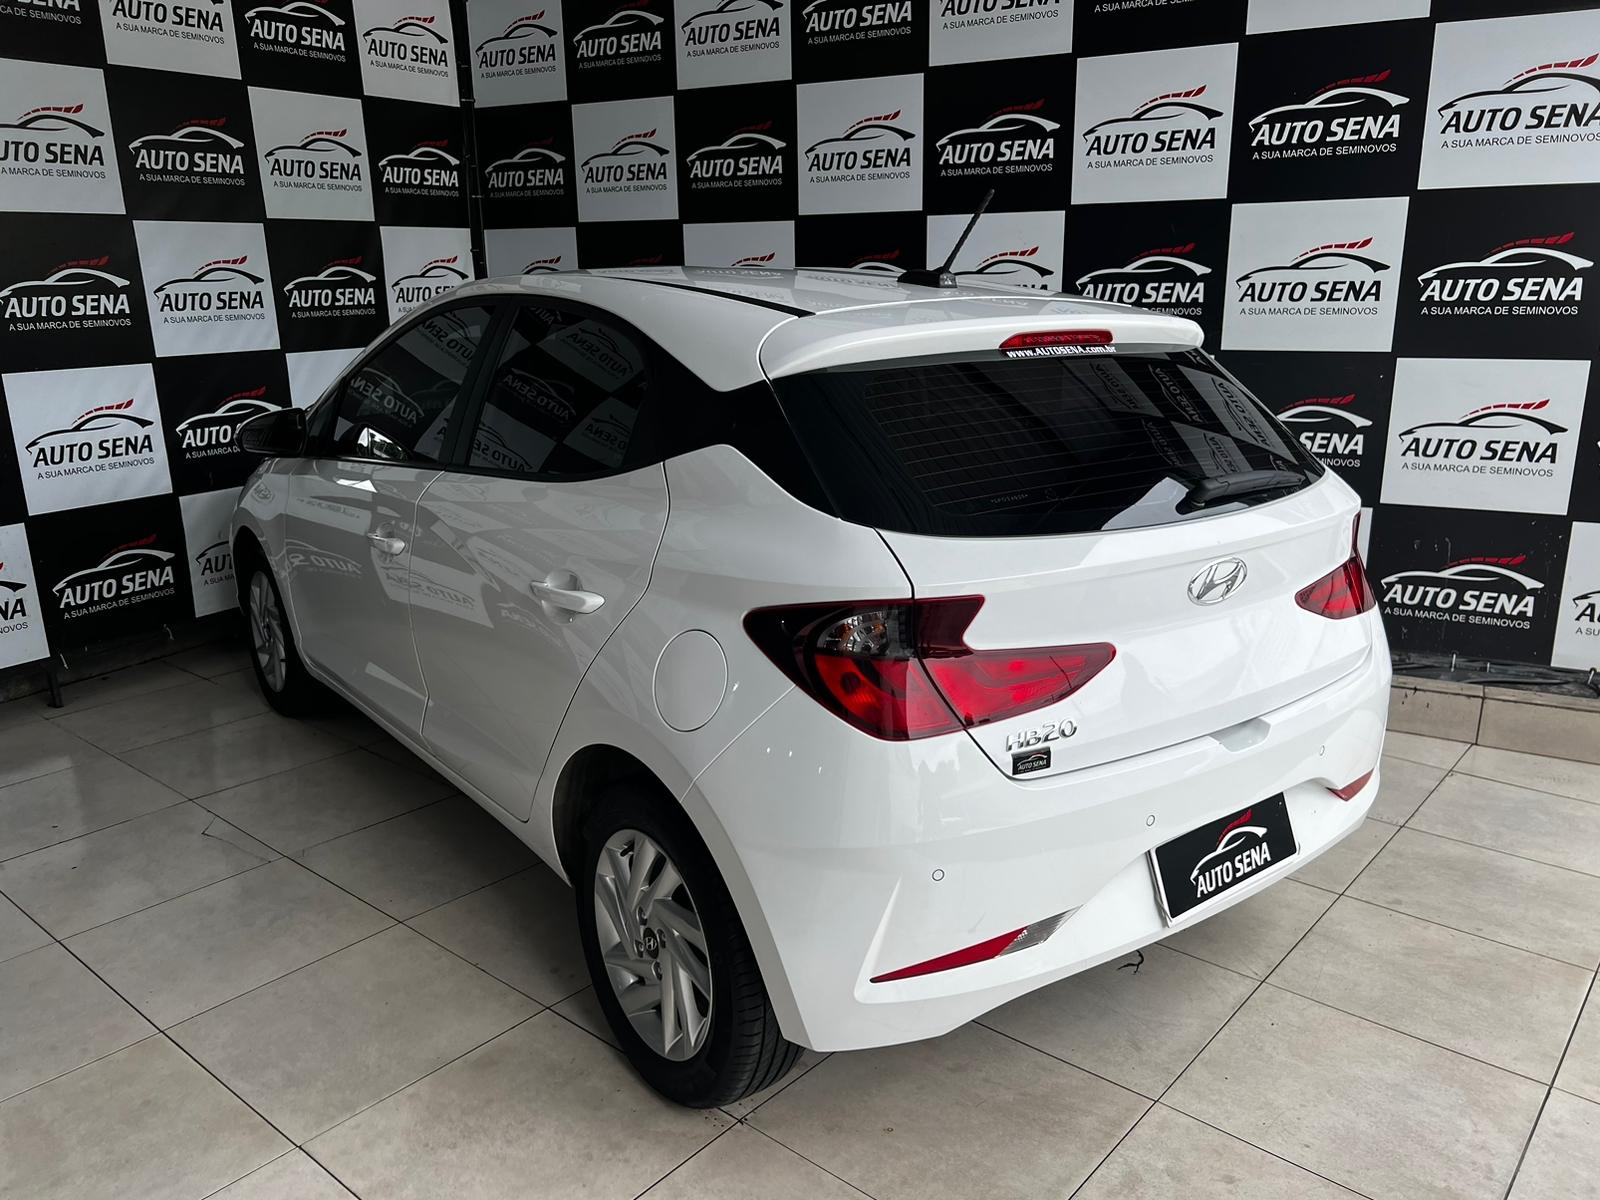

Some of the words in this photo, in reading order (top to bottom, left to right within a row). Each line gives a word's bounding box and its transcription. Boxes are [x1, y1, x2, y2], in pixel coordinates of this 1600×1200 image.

[14, 7, 27, 16] DE
[28, 9, 82, 24] SEMINOVOS
[112, 0, 167, 23] AUTO
[171, 5, 224, 32] SENA
[806, 8, 857, 33] AUTO
[859, 0, 912, 27] SENA
[1094, 4, 1101, 13] A
[1102, 2, 1120, 12] SUA
[1121, 0, 1154, 10] MARCA
[685, 23, 730, 46] AUTO
[733, 17, 780, 41] SENA
[942, 22, 949, 30] A
[949, 18, 966, 30] SUA
[966, 16, 996, 28] MARCA
[996, 14, 1008, 24] DE
[1009, 10, 1059, 22] SEMINOVOS
[116, 22, 122, 30] A
[123, 23, 140, 32] SUA
[140, 25, 168, 36] MARCA
[169, 29, 180, 38] DE
[181, 31, 224, 44] SEMINOVOS
[250, 19, 297, 43] AUTO
[301, 26, 345, 51] SENA
[576, 36, 617, 58] AUTO
[619, 31, 661, 54] SENA
[367, 38, 407, 60] AUTO
[410, 45, 448, 68] SENA
[479, 48, 516, 69] AUTO
[518, 43, 556, 65] SENA
[1440, 107, 1522, 134] AUTO
[1524, 101, 1600, 130] SENA
[1086, 132, 1149, 156] AUTO
[1151, 127, 1215, 152] SENA
[1251, 120, 1324, 146] AUTO
[1326, 114, 1400, 142] SENA
[0, 140, 40, 163] UTO
[44, 142, 104, 166] SENA
[939, 142, 995, 165] AUTO
[997, 138, 1054, 161] SENA
[1261, 150, 1280, 159] SUA
[1282, 148, 1317, 158] MARCA
[1319, 147, 1333, 156] DE
[1336, 143, 1396, 155] SEMINOVOS
[1441, 140, 1449, 148] A
[1451, 139, 1473, 148] SUA
[1475, 137, 1514, 146] MARCA
[1517, 136, 1532, 145] DE
[135, 149, 189, 171] AUTO
[193, 152, 244, 174] SENA
[270, 158, 316, 178] AUTO
[319, 161, 362, 181] SENA
[690, 158, 734, 178] AUTO
[737, 155, 782, 176] SENA
[808, 151, 858, 172] AUTO
[860, 147, 911, 169] SENA
[1095, 160, 1112, 168] SUA
[1113, 159, 1144, 167] MARCA
[1146, 158, 1158, 166] DE
[1160, 154, 1213, 165] SEMINOVOS
[8, 166, 40, 176] MARCA
[42, 168, 54, 177] DE
[56, 168, 106, 180] SEMINOVOS
[163, 174, 190, 183] MARCA
[191, 176, 202, 184] DE
[203, 177, 245, 186] SEMINOVOS
[382, 166, 421, 185] AUTO
[423, 169, 459, 187] SENA
[488, 170, 524, 188] AUTO
[526, 168, 564, 186] SENA
[584, 165, 624, 184] AUTO
[626, 162, 667, 181] SENA
[831, 174, 855, 182] MARCA
[868, 171, 910, 180] SEMINOVOS
[289, 289, 332, 308] AUTO
[335, 288, 375, 306] SENA
[396, 286, 432, 304] AUTO
[1081, 282, 1140, 304] AUTO
[1141, 282, 1204, 304] SENA
[1238, 281, 1308, 302] AUTO
[1310, 280, 1381, 302] SENA
[1420, 279, 1500, 301] AUTO
[1502, 277, 1583, 301] SENA
[4, 296, 66, 318] AUTO
[71, 294, 130, 316] SENA
[160, 292, 212, 312] AUTO
[216, 291, 264, 310] SENA
[1268, 307, 1302, 315] MARCA
[1304, 307, 1317, 315] DE
[1319, 307, 1378, 315] SEMINOVOS
[1431, 307, 1452, 315] SUA
[1454, 306, 1492, 315] MARCA
[1494, 306, 1509, 315] DE
[1512, 306, 1578, 315] SEMINOVOS
[9, 323, 16, 331] A
[17, 322, 36, 331] SUA
[36, 321, 68, 329] MARCA
[69, 320, 81, 328] DE
[82, 318, 131, 328] SEMINOVOS
[182, 424, 232, 448] AUTO
[1299, 432, 1364, 456] SENA
[33, 442, 93, 468] AUTO
[97, 434, 154, 459] SENA
[1400, 437, 1477, 460] AUTO
[1479, 440, 1558, 464] SENA
[45, 470, 63, 478] SUA
[64, 466, 94, 476] MARCA
[95, 463, 106, 472] DE
[108, 457, 154, 470] SEMINOVOS
[1411, 462, 1431, 470] SUA
[1433, 463, 1470, 472] MARCA
[1472, 465, 1487, 474] DE
[1489, 466, 1553, 477] SEMINOVOS
[201, 554, 233, 576] AUT
[60, 578, 117, 609] AUTO
[121, 566, 174, 594] SENA
[1384, 584, 1457, 608] AUTO
[1459, 590, 1534, 617] SENA
[1394, 608, 1413, 616] SUA
[1415, 610, 1450, 620] MARCA
[1452, 614, 1466, 622] DE
[1468, 616, 1530, 629] SEMINOVOS
[1006, 718, 1078, 752] HB20
[1196, 860, 1233, 898] AUTO
[1234, 842, 1272, 878] SENA
